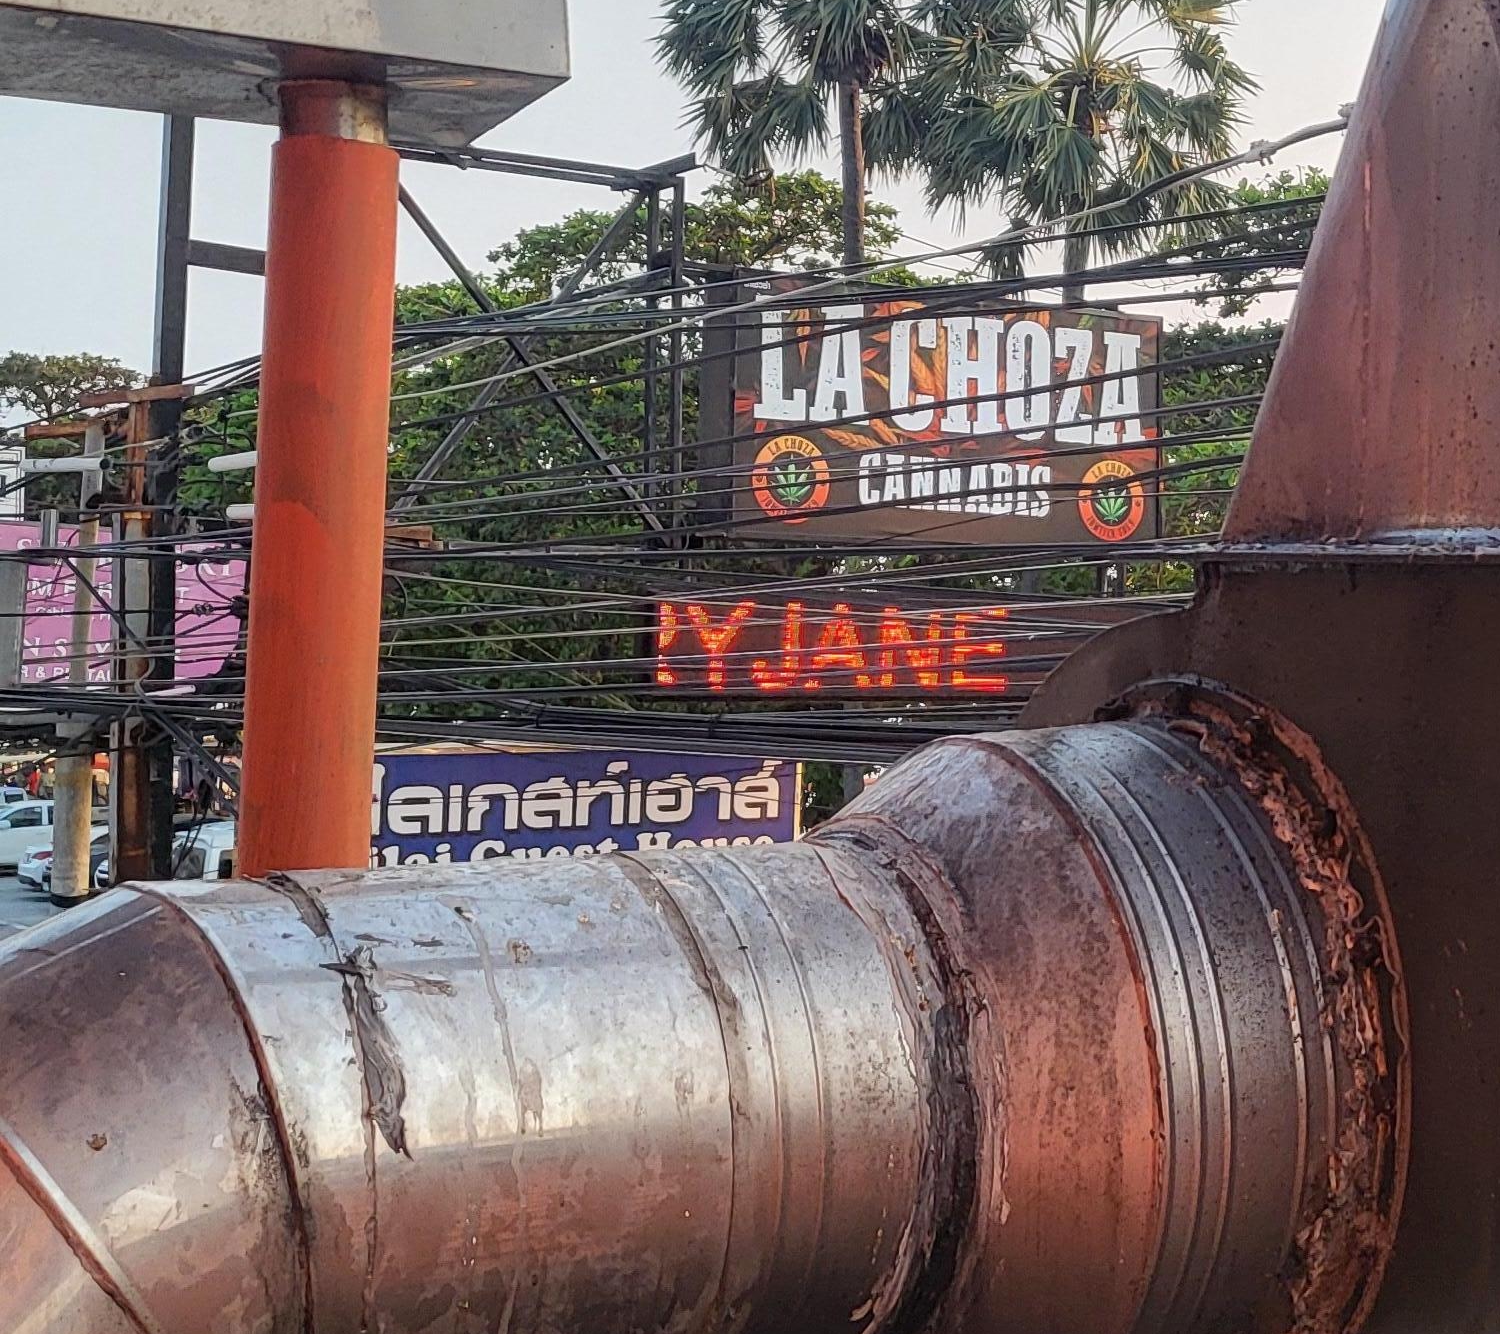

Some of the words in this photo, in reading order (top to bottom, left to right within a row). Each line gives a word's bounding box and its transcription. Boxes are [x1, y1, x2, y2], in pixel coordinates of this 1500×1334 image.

[754, 294, 870, 425] LA
[890, 316, 1148, 446] CHOZA
[784, 437, 815, 455] CHOZA
[858, 452, 1053, 518] CANNABIS
